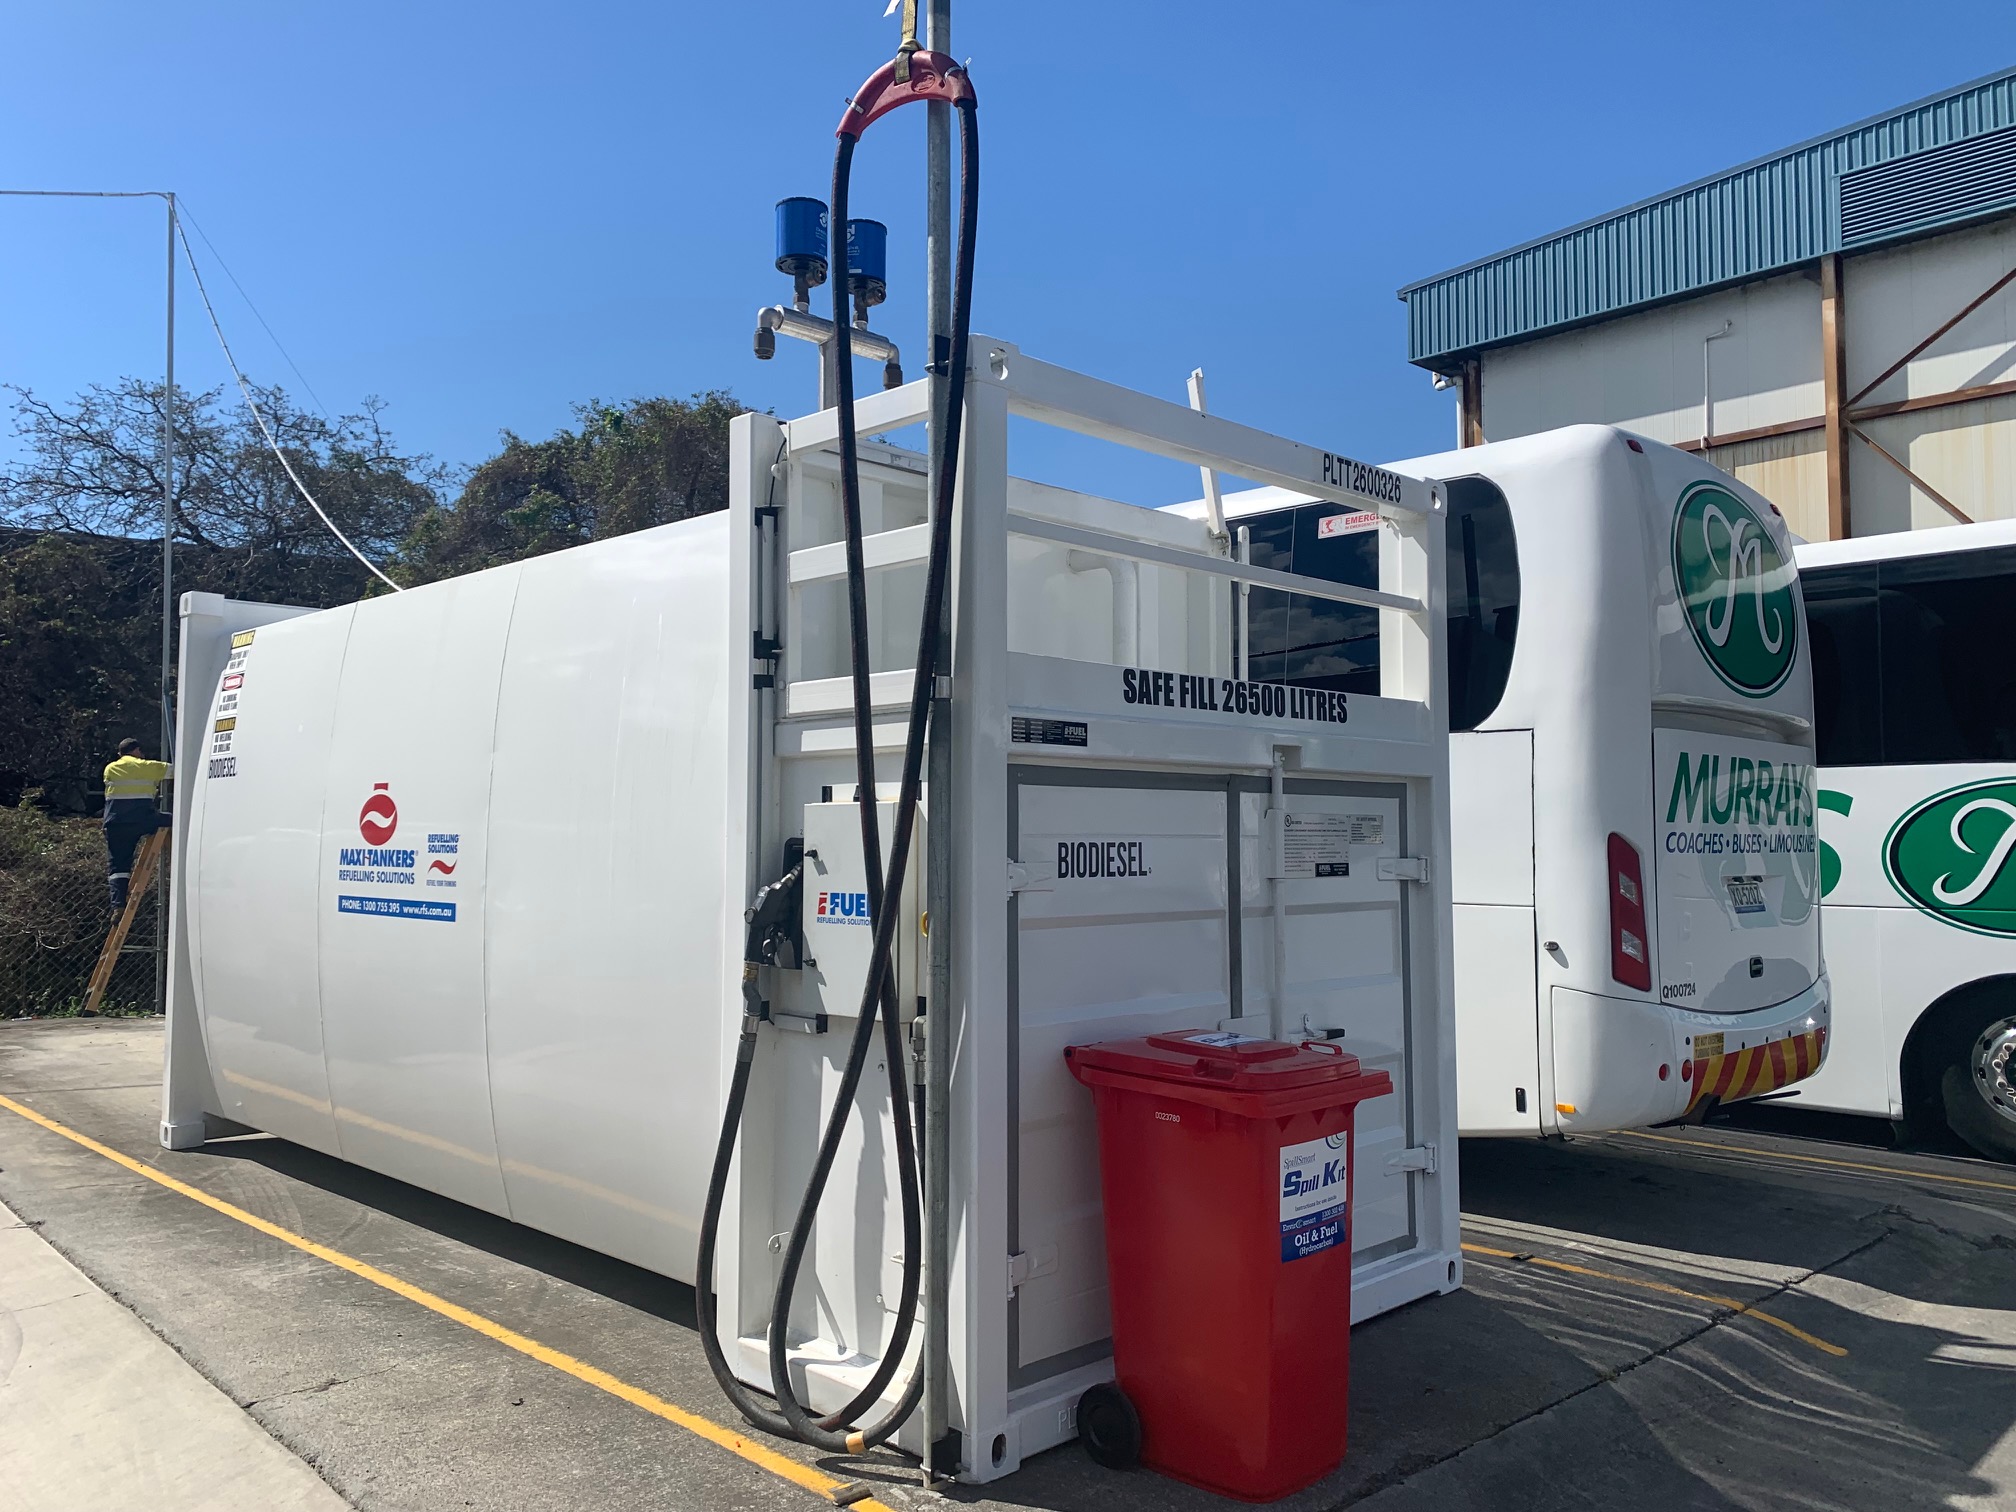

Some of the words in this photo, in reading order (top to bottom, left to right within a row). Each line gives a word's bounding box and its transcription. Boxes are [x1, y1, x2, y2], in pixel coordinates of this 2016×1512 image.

[1123, 668, 1174, 707] SAFE
[1179, 674, 1218, 711] FILL
[1222, 680, 1286, 718] 26500
[1290, 687, 1348, 723] LITRES
[208, 757, 236, 779] BIODIESEL
[427, 834, 459, 844] REFUELLING
[1666, 832, 1724, 854] COACHES
[1732, 834, 1762, 854] BUSES
[427, 844, 458, 854] SOLUTIONS
[1057, 842, 1148, 878] BIODIESEL
[339, 870, 374, 883] REFUELLING
[376, 871, 415, 885] SOLUTIONS
[341, 899, 361, 910] PHONE:
[362, 900, 376, 911] 1300
[376, 902, 388, 912] 755
[388, 903, 400, 913] 395
[403, 904, 452, 917] www.rfs.com.au
[817, 916, 846, 925] REFUELLING
[1662, 982, 1696, 999] Q100724
[1283, 1153, 1316, 1170] SpillSmart
[1283, 1169, 1320, 1198] Spill
[1322, 1159, 1346, 1187] Kit
[1294, 1231, 1309, 1247] Oil
[1311, 1229, 1319, 1241] &
[1320, 1222, 1338, 1239] Fuel
[1299, 1237, 1334, 1257] (Hydrocarbon)
